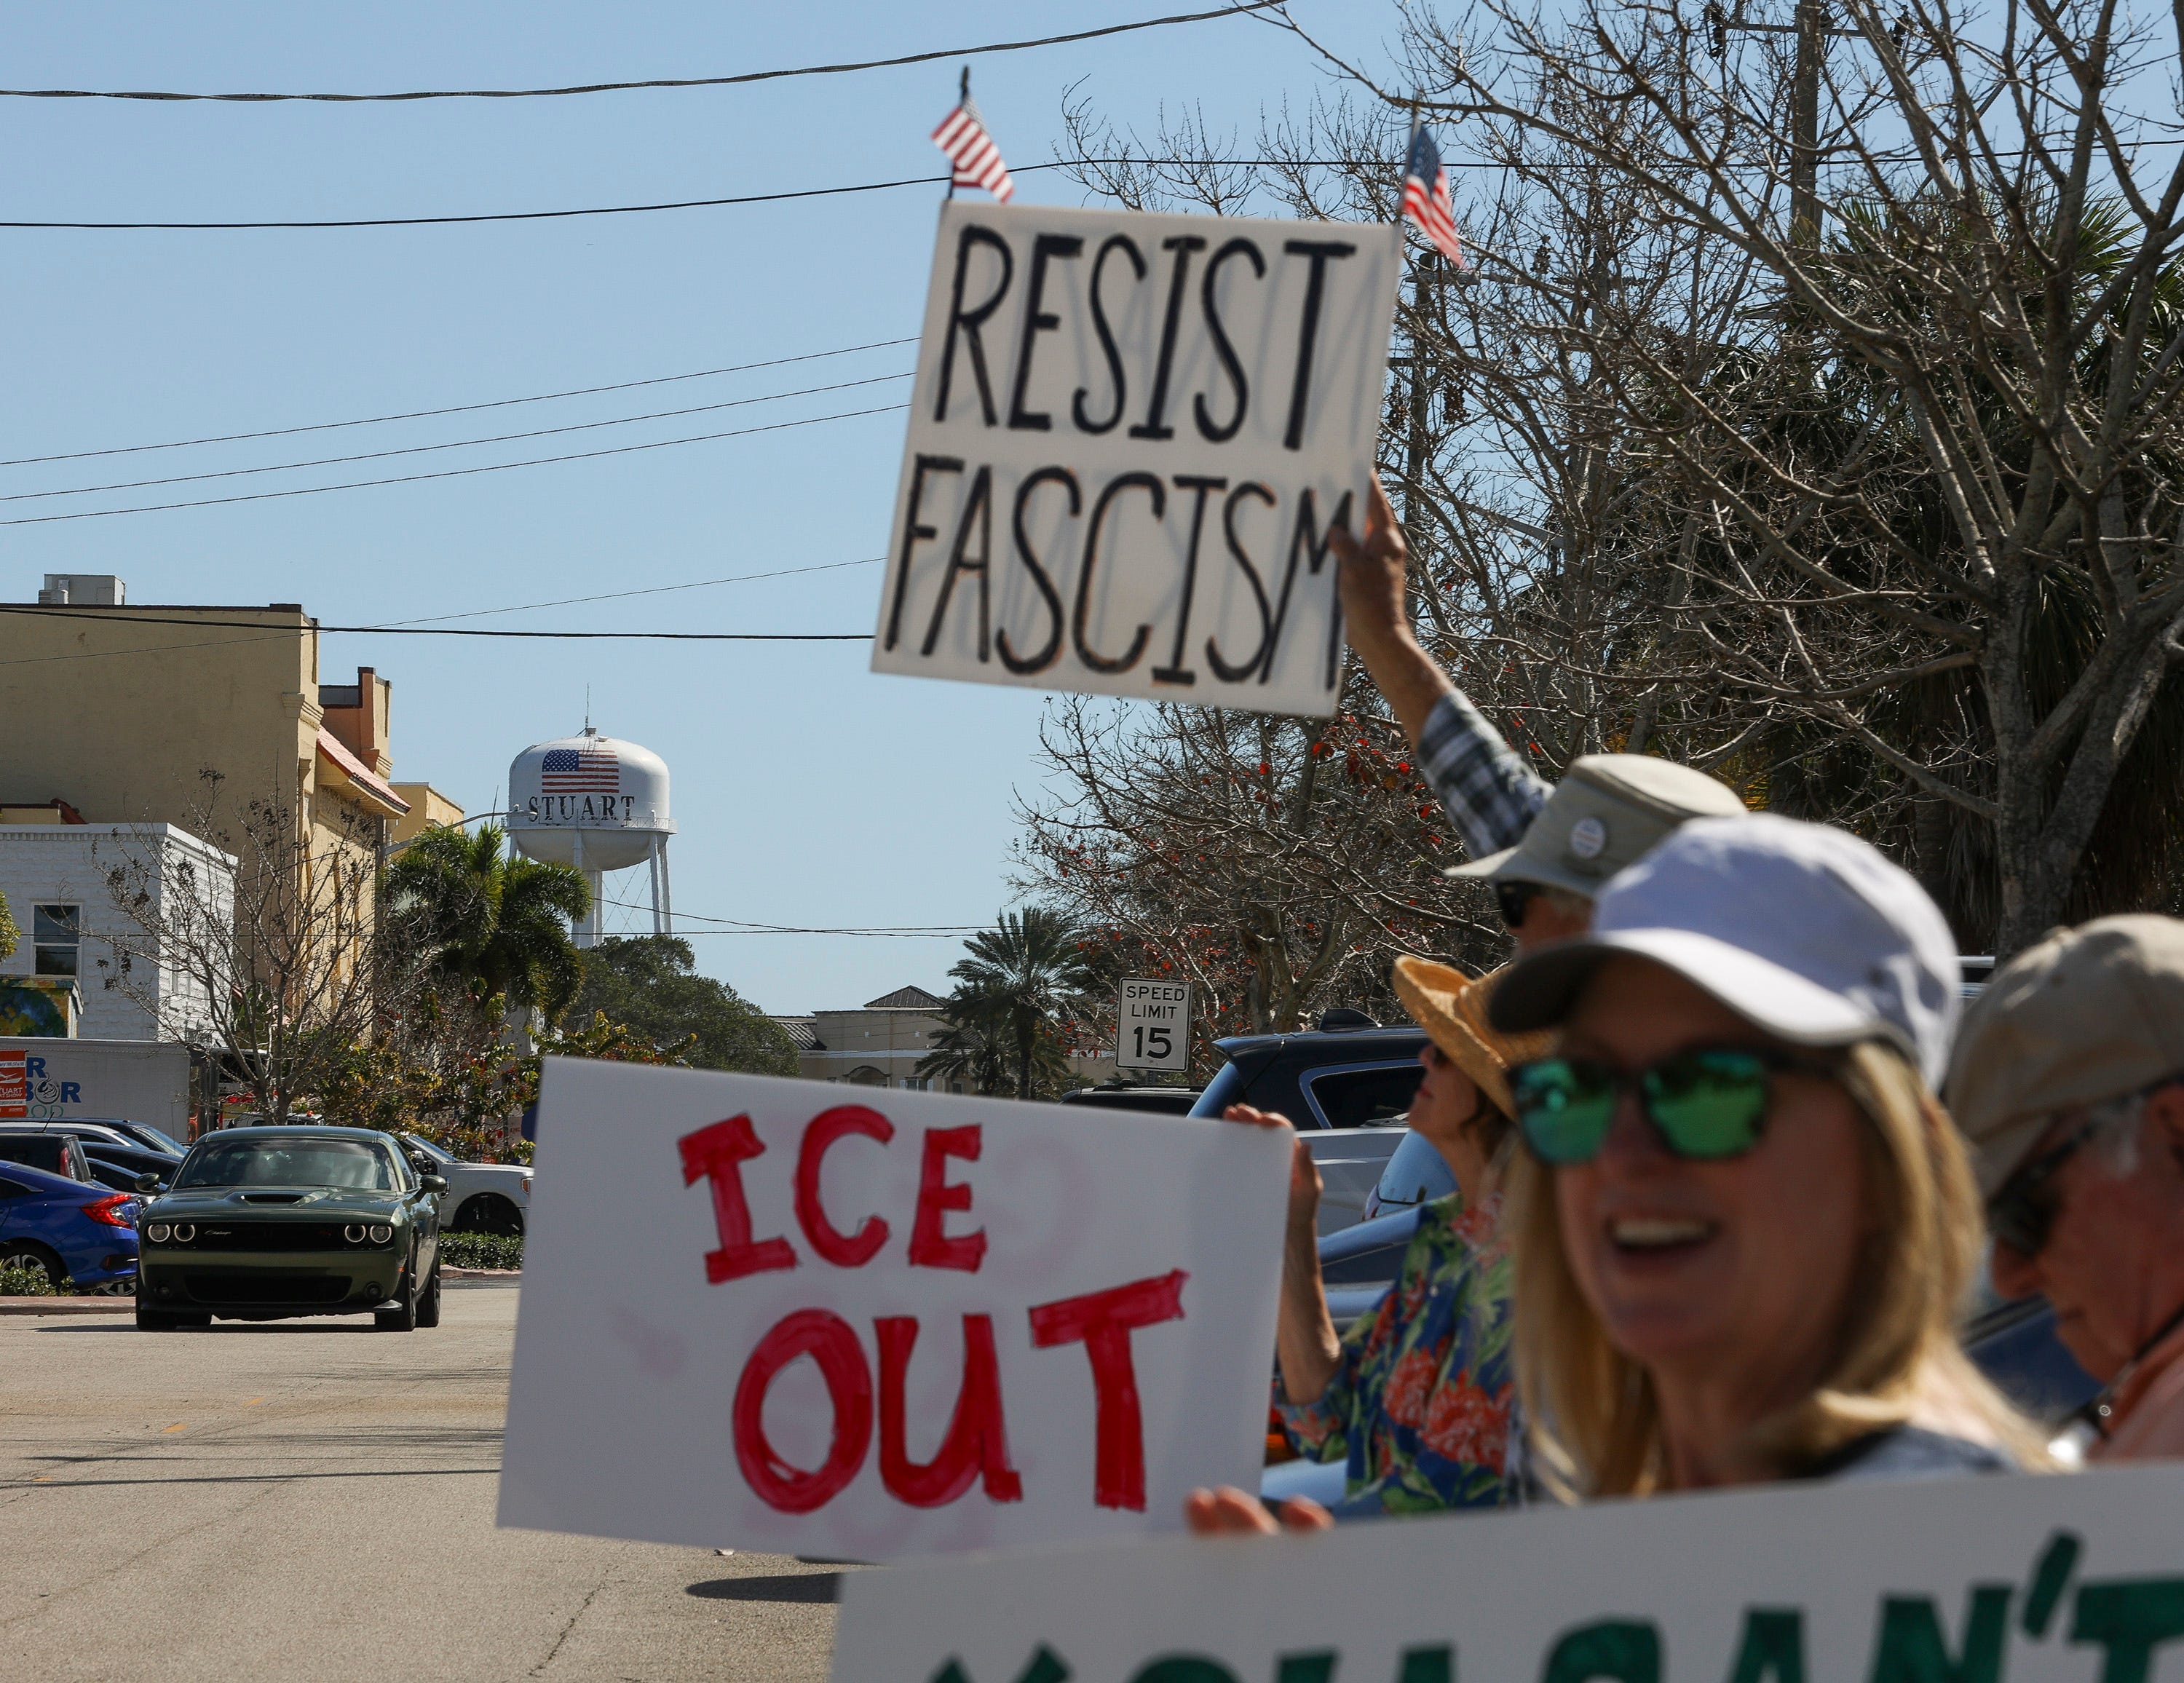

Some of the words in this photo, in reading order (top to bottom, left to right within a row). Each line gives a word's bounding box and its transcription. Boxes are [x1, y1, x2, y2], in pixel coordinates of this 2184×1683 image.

[933, 223, 1358, 452] RESIST
[883, 452, 1356, 692] FASCISM
[528, 794, 635, 823] STUART
[1126, 985, 1185, 1002] SPEED
[1131, 1004, 1178, 1019] LIMIT
[1133, 1026, 1172, 1059] 15
[677, 1104, 988, 1285] ICE
[732, 1269, 1190, 1514] OUT
